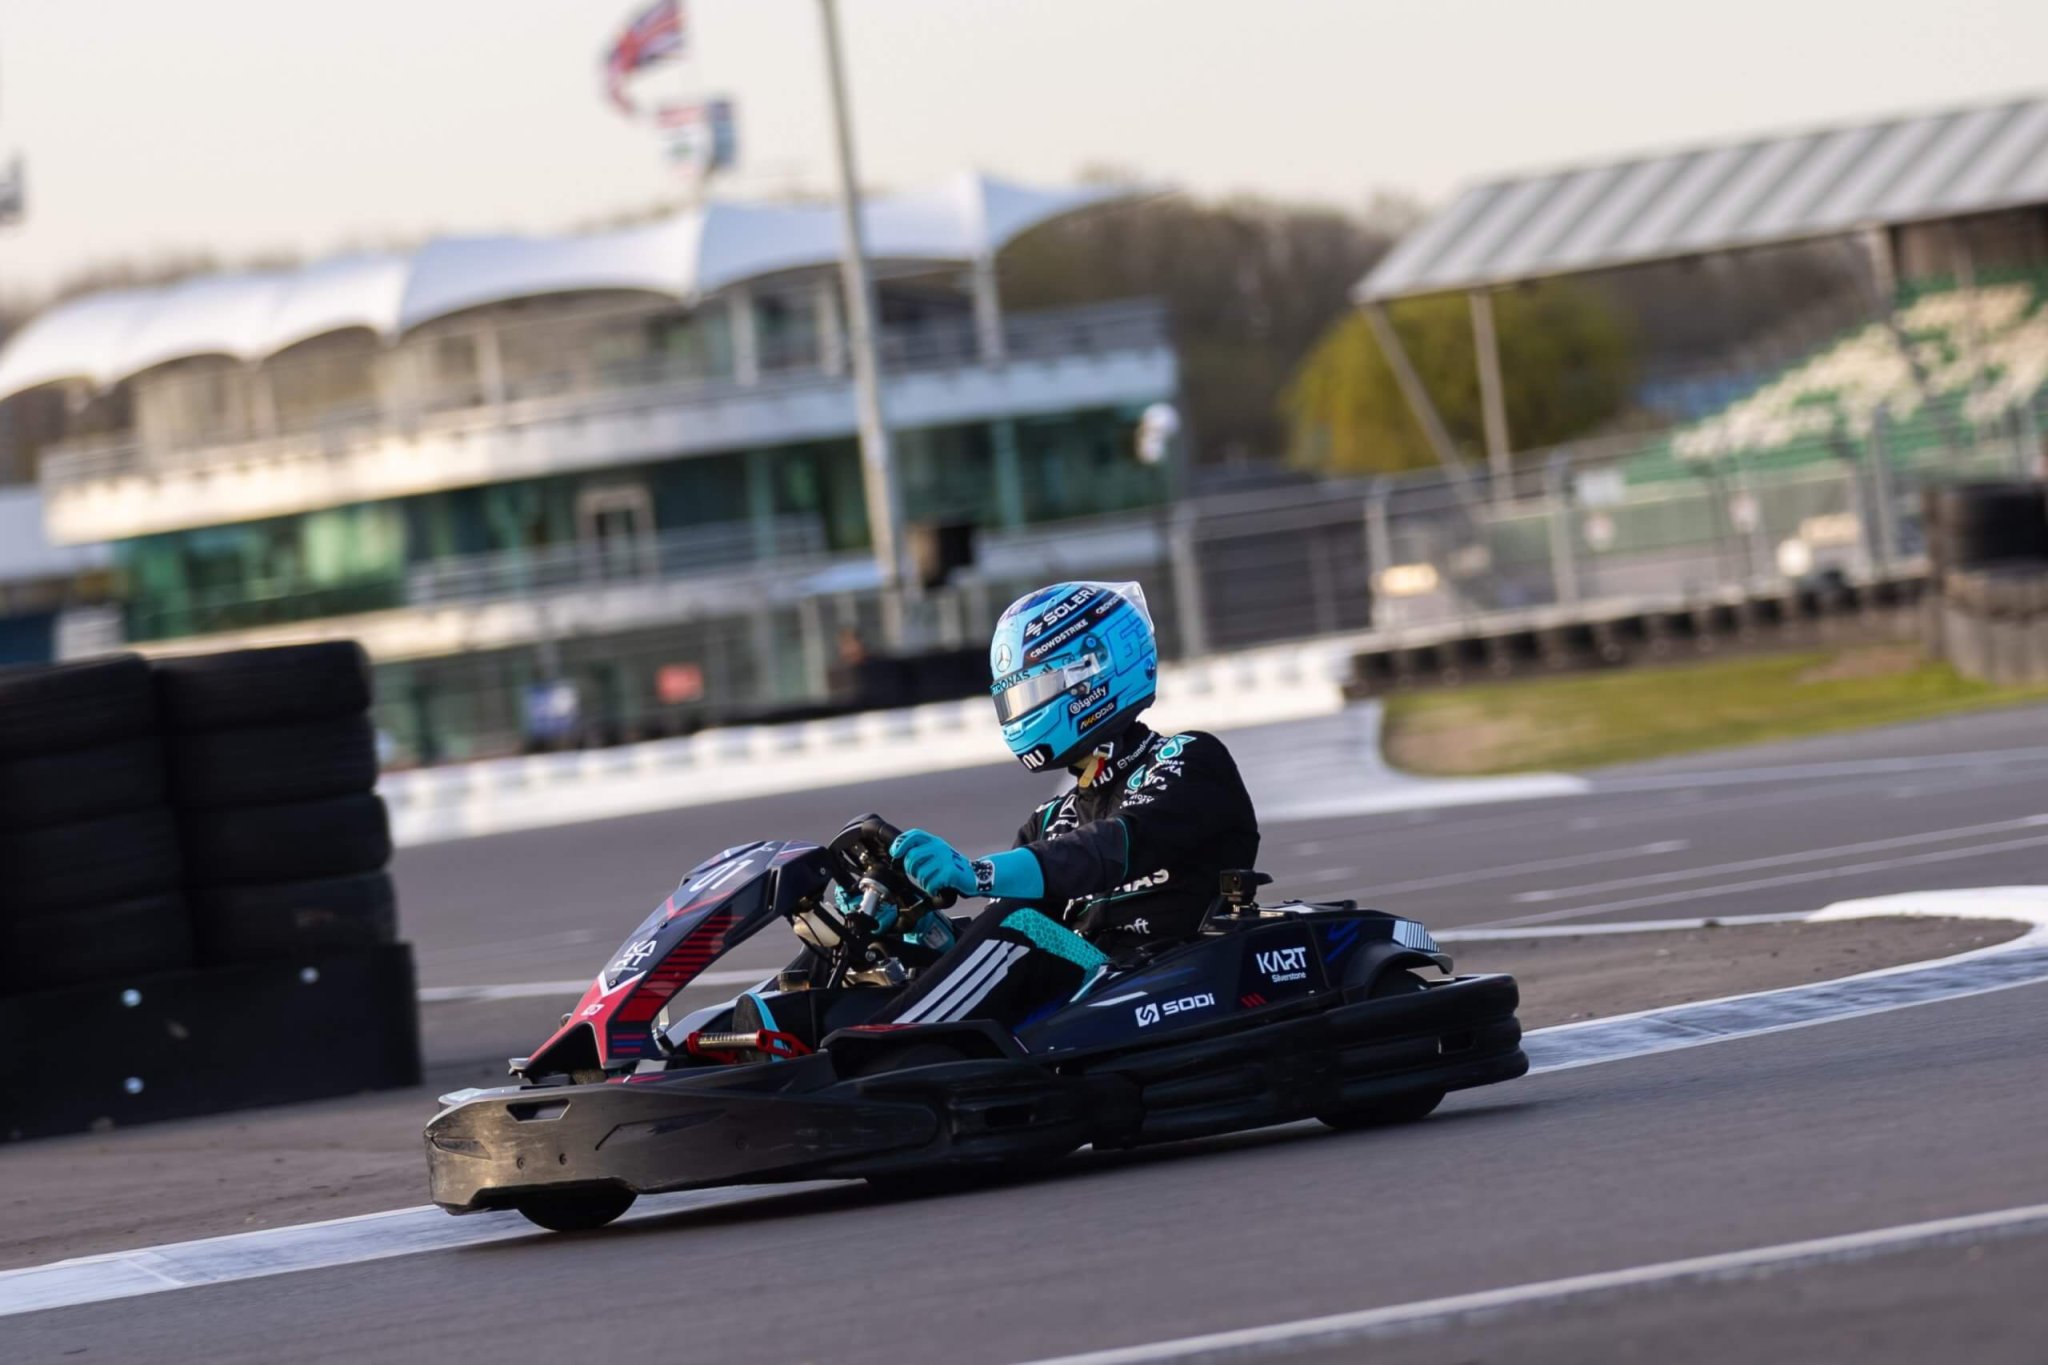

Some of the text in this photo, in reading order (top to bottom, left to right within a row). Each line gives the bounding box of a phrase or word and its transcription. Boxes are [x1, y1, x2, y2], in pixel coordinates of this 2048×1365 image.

[1030, 619, 1089, 658] CROWDSTRIKE
[1256, 946, 1307, 974] KART
[1162, 992, 1216, 1016] SODI
